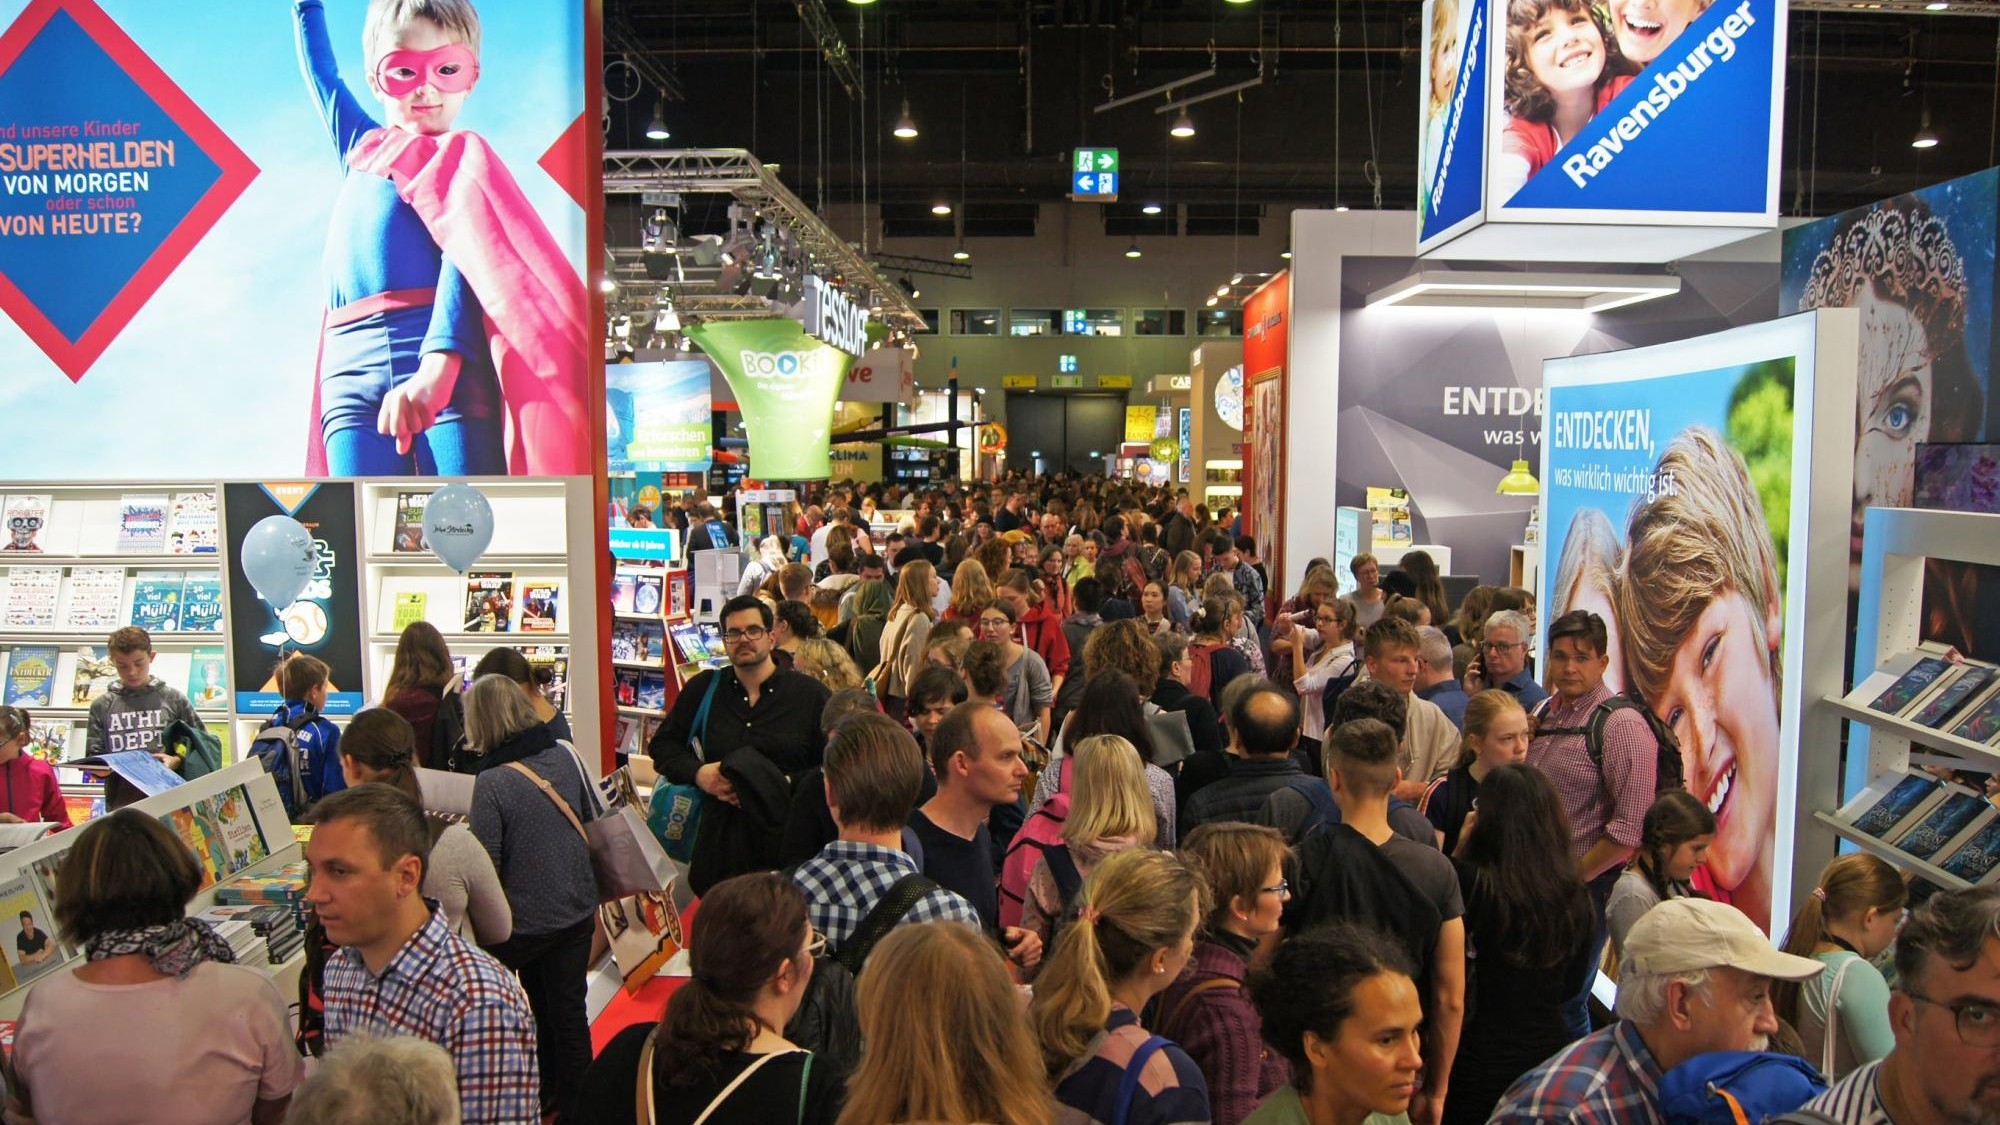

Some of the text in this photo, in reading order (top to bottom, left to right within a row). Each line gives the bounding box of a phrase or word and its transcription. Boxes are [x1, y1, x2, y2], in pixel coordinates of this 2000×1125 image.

[1561, 0, 1756, 189] Ravensburger
[1432, 6, 1483, 216] Ravensburger
[22, 125, 79, 139] unsere
[84, 120, 141, 137] Kinder
[0, 139, 175, 172] SUPERHELDEN
[3, 171, 149, 195] VON MORGEN
[46, 193, 136, 211] oder schon
[0, 212, 142, 236] VON HEUTE?
[1483, 429, 1524, 445] was
[1555, 409, 1655, 459] ENTDECKEN,
[1555, 464, 1678, 504] was wirklich wichtig ist.
[140, 603, 174, 617] Müll!
[190, 603, 222, 617] Müll!
